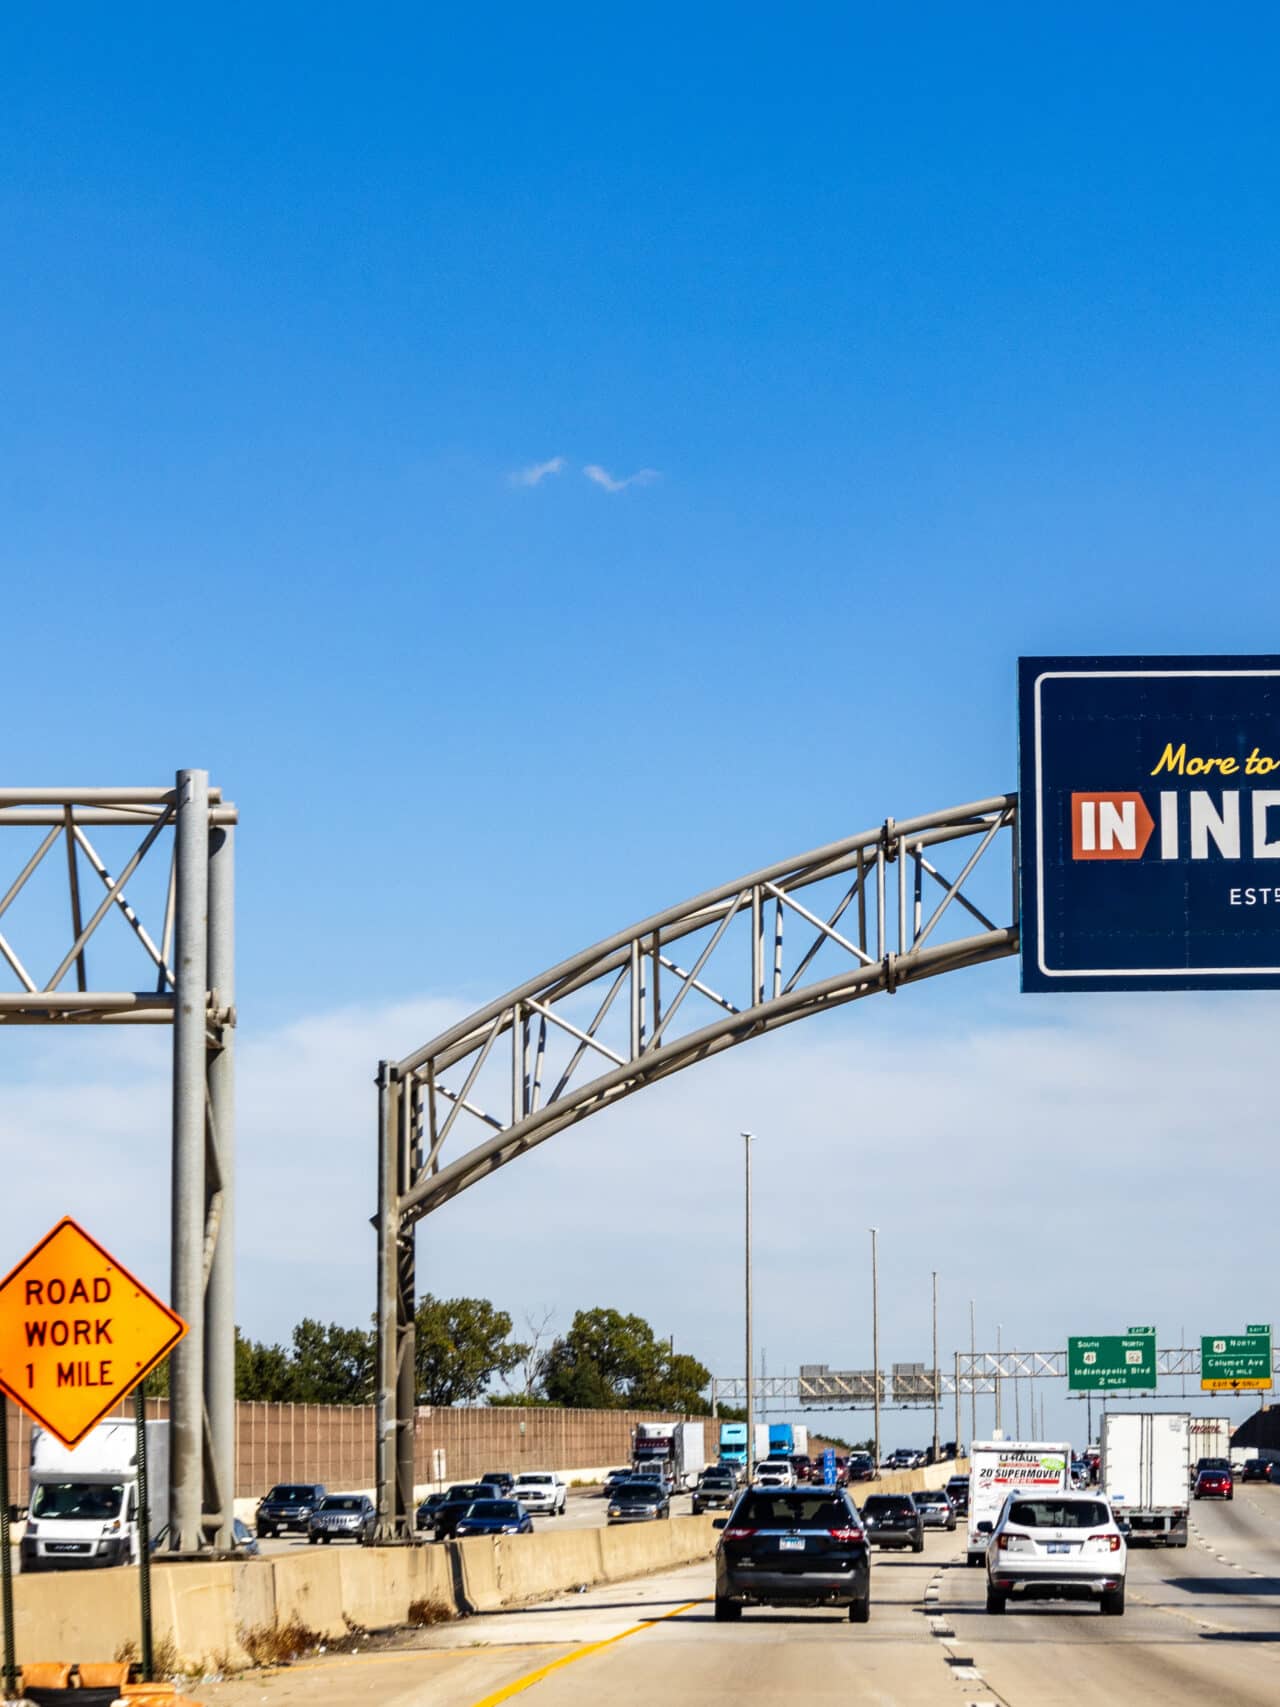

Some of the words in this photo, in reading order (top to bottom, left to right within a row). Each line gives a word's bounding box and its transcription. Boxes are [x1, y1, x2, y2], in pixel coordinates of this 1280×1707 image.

[1151, 743, 1239, 776] More
[1245, 748, 1280, 775] to
[1081, 801, 1136, 851] IN
[25, 1277, 112, 1306] ROAD
[25, 1318, 113, 1347] WORK
[1147, 1327, 1153, 1335] 2
[1121, 1340, 1144, 1348] NORTH
[1229, 1339, 1256, 1347] NORTH
[1208, 1358, 1244, 1367] Calumet
[1248, 1358, 1264, 1367] Ave
[26, 1363, 34, 1389] 1
[56, 1360, 113, 1388] MILE
[1074, 1367, 1127, 1377] Indianapolis
[1131, 1366, 1151, 1375] Blvd
[1098, 1377, 1105, 1386] 2
